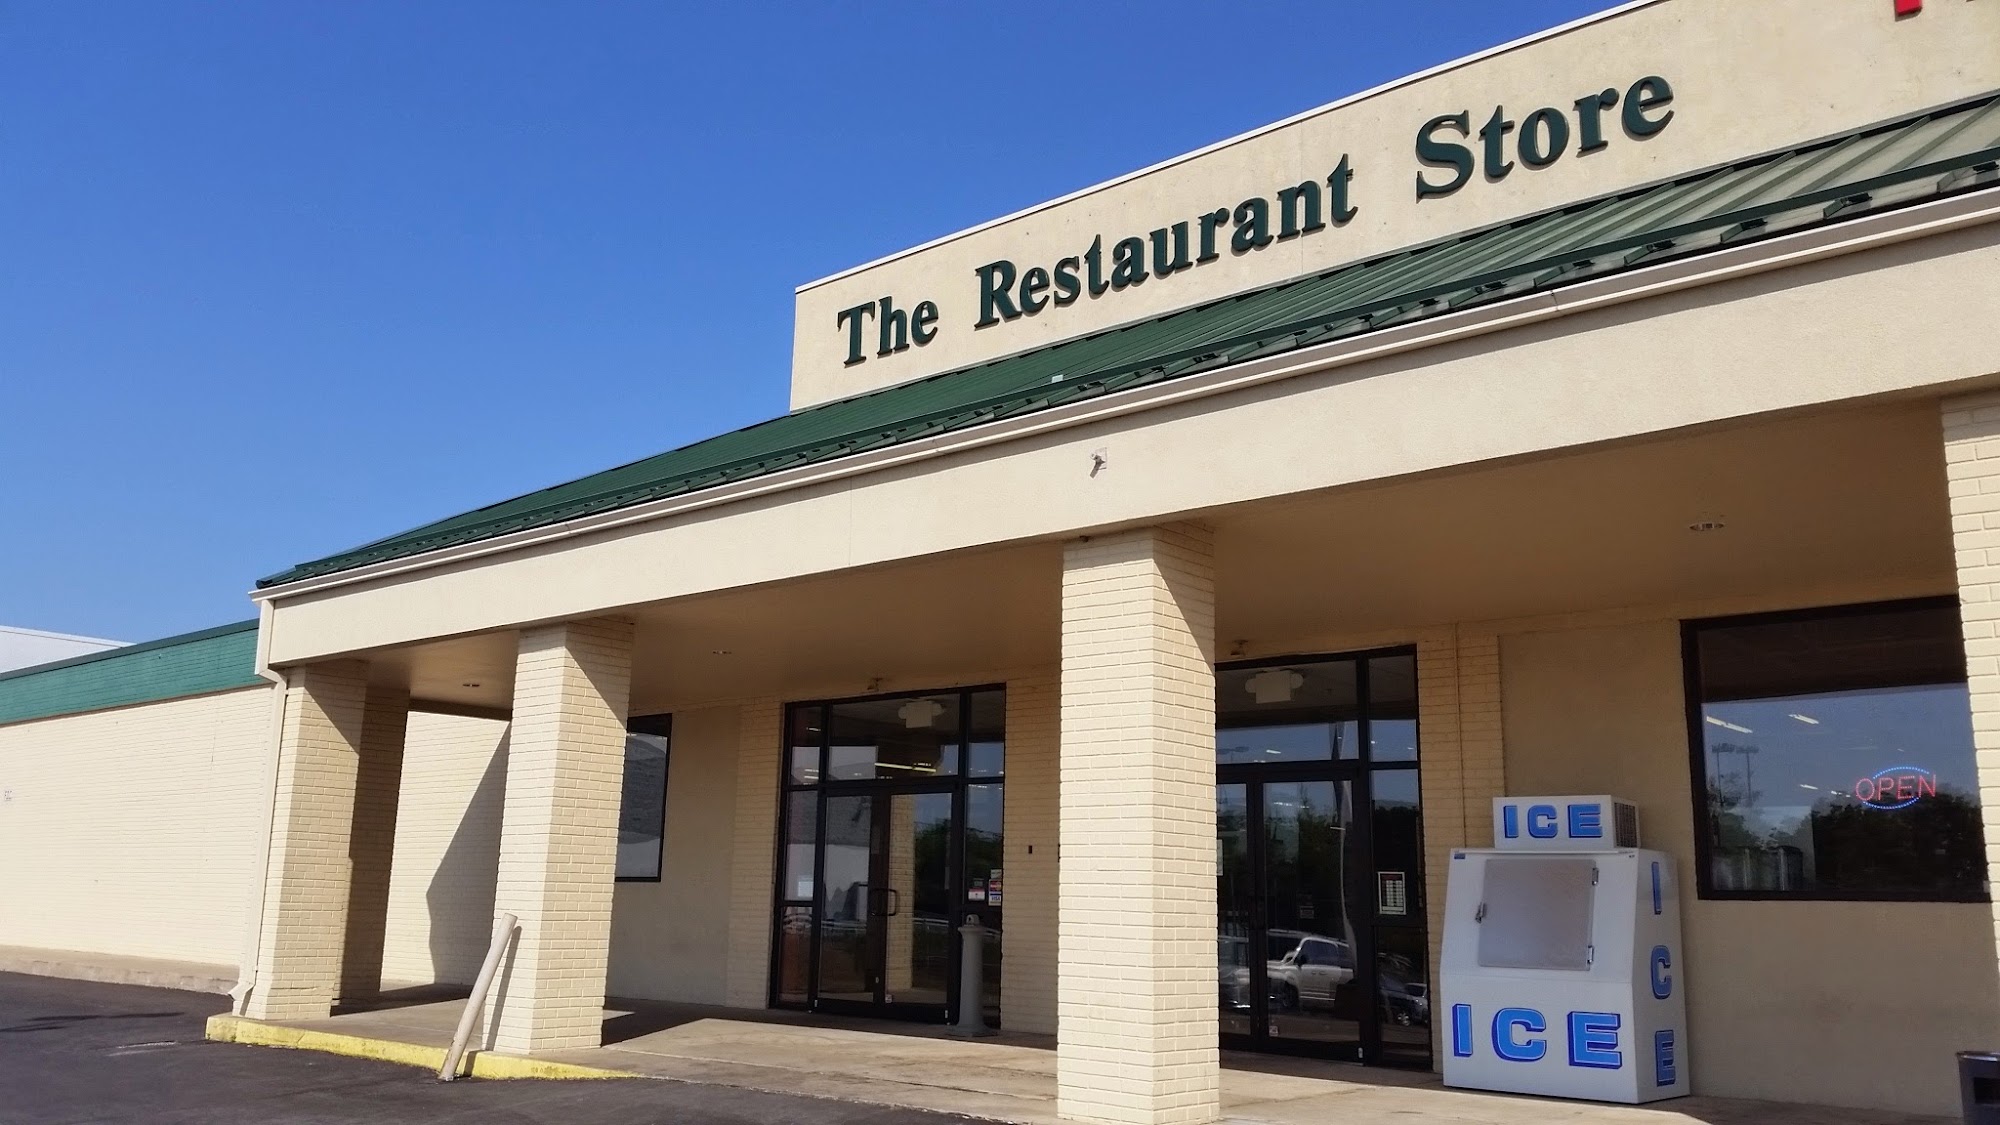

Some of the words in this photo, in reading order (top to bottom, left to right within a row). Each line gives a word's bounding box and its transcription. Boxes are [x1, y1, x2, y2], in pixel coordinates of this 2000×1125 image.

[837, 297, 939, 367] The
[974, 153, 1358, 329] Restaurant
[1415, 75, 1674, 199] Store
[1855, 773, 1937, 801] OPEN
[1503, 804, 1603, 839] ICE
[1651, 861, 1677, 1088] ICE
[1452, 1003, 1623, 1070] ICE
